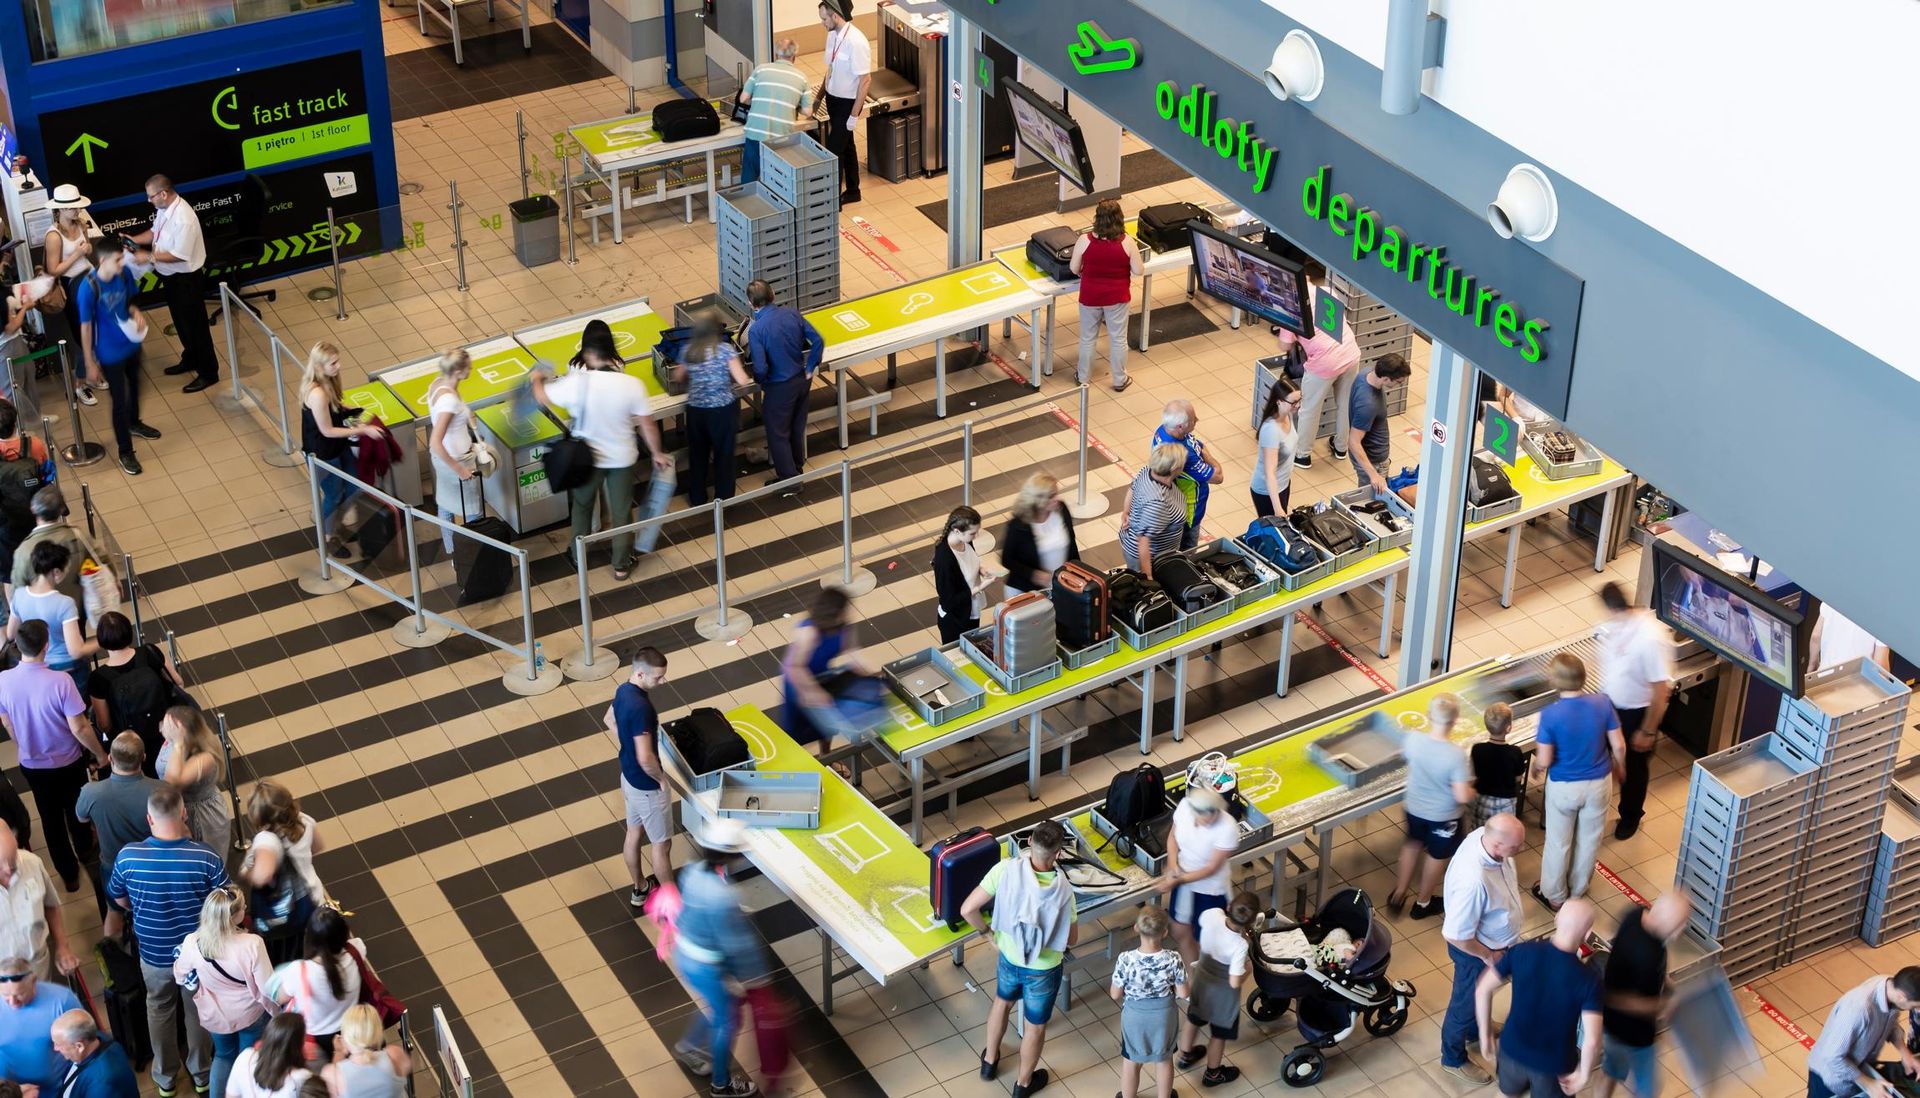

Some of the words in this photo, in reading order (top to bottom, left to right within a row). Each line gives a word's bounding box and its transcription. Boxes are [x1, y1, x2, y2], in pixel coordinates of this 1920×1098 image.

[979, 58, 989, 87] 4
[252, 102, 292, 126] fast
[297, 88, 348, 116] track
[312, 129, 324, 139] 1st
[327, 124, 351, 136] floor
[257, 142, 262, 151] 1
[265, 136, 296, 152] piętro
[212, 197, 233, 207] Fast
[1156, 81, 1274, 193] odloty
[1302, 165, 1544, 363] departures
[1322, 297, 1336, 331] 3
[1492, 416, 1509, 456] 2
[529, 472, 545, 482] 100
[1609, 876, 1627, 891] ENTER
